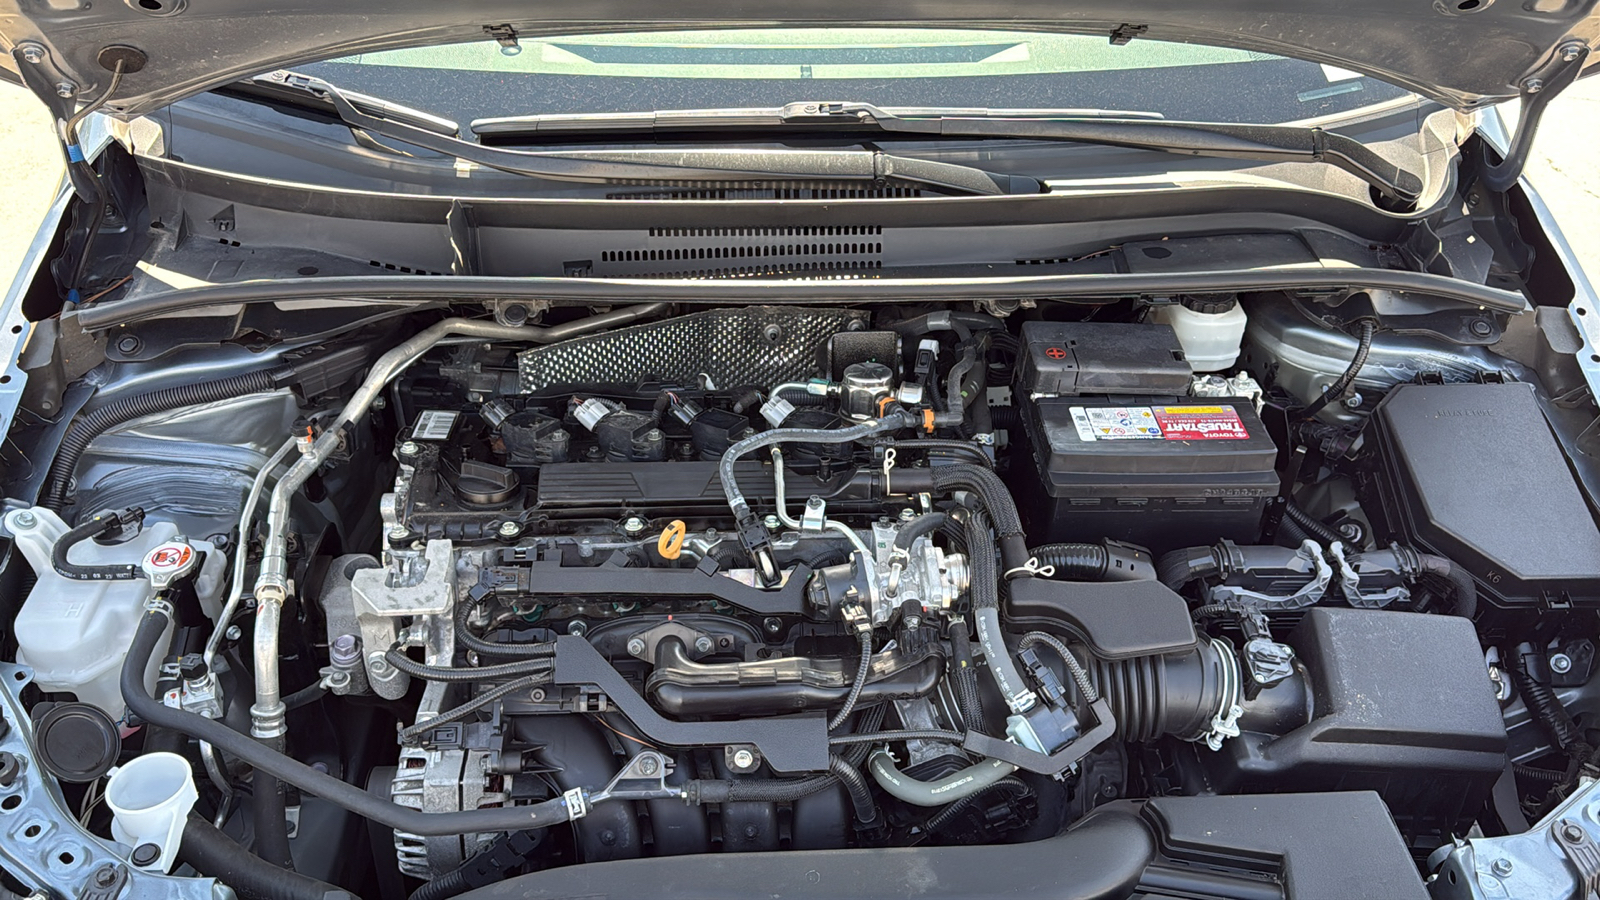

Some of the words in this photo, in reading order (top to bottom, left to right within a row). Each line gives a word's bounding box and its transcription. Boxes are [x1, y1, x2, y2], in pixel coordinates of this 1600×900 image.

[1165, 422, 1244, 433] TRUESTART
[1486, 570, 1502, 584] K6
[64, 602, 85, 618] H
[371, 628, 391, 646] M
